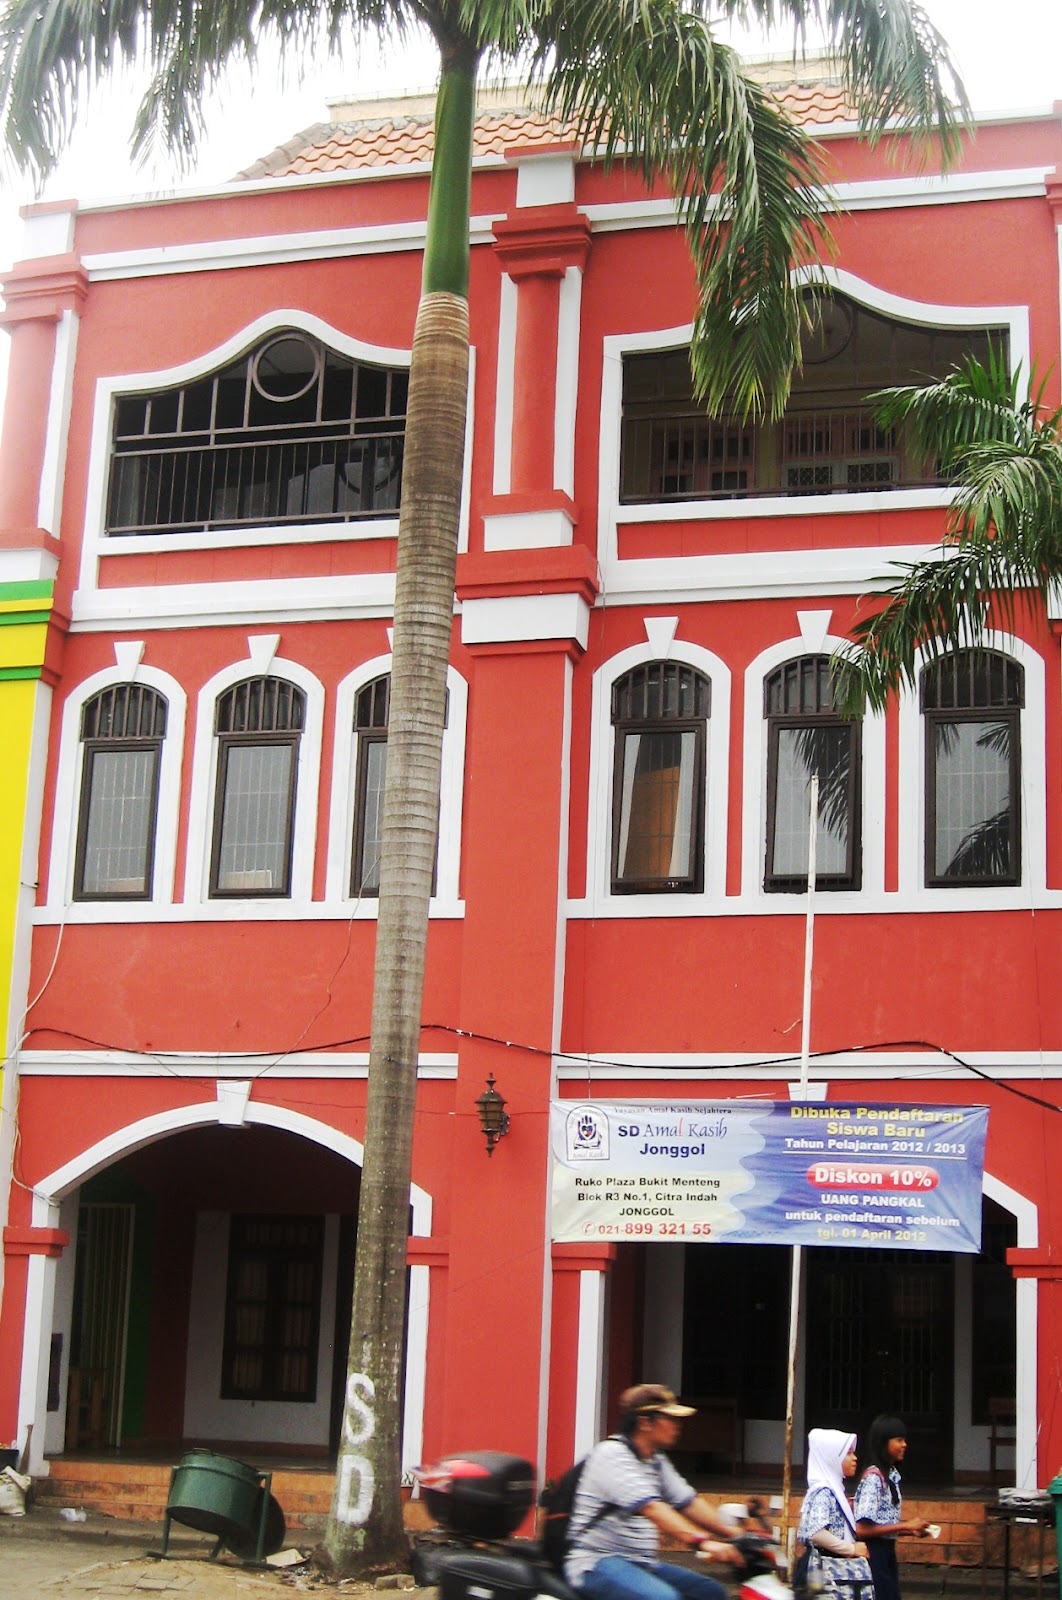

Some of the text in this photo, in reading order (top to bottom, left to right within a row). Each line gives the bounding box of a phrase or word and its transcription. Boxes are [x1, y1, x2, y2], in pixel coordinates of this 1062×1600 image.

[695, 1107, 732, 1115] Sejahtera
[790, 1106, 964, 1122] Dibuka Pendaftaran
[618, 1117, 728, 1140] SD Amal Kasih
[827, 1121, 926, 1138] Siswa Baru
[640, 1143, 705, 1158] Jonggol
[785, 1138, 824, 1149] Tahun
[828, 1139, 888, 1152] Pelajaran
[891, 1141, 923, 1152] 2012
[934, 1142, 966, 1154] 2013
[575, 1178, 721, 1189] Ruko Plaza Bukit Menteng
[815, 1167, 932, 1187] Diskon 10%
[578, 1193, 602, 1201] Blok
[605, 1193, 620, 1201] R3
[655, 1193, 683, 1201] Citra
[686, 1193, 718, 1201] Indah
[821, 1194, 925, 1208] UANG PANGKAL
[619, 1208, 675, 1216] JONGGOL
[785, 1211, 960, 1227] untuk pendaftaran sebelum
[659, 1223, 686, 1235] 321
[692, 1224, 712, 1235] 55
[842, 1229, 857, 1238] 01
[861, 1229, 891, 1241] April
[895, 1231, 927, 1242] 2012
